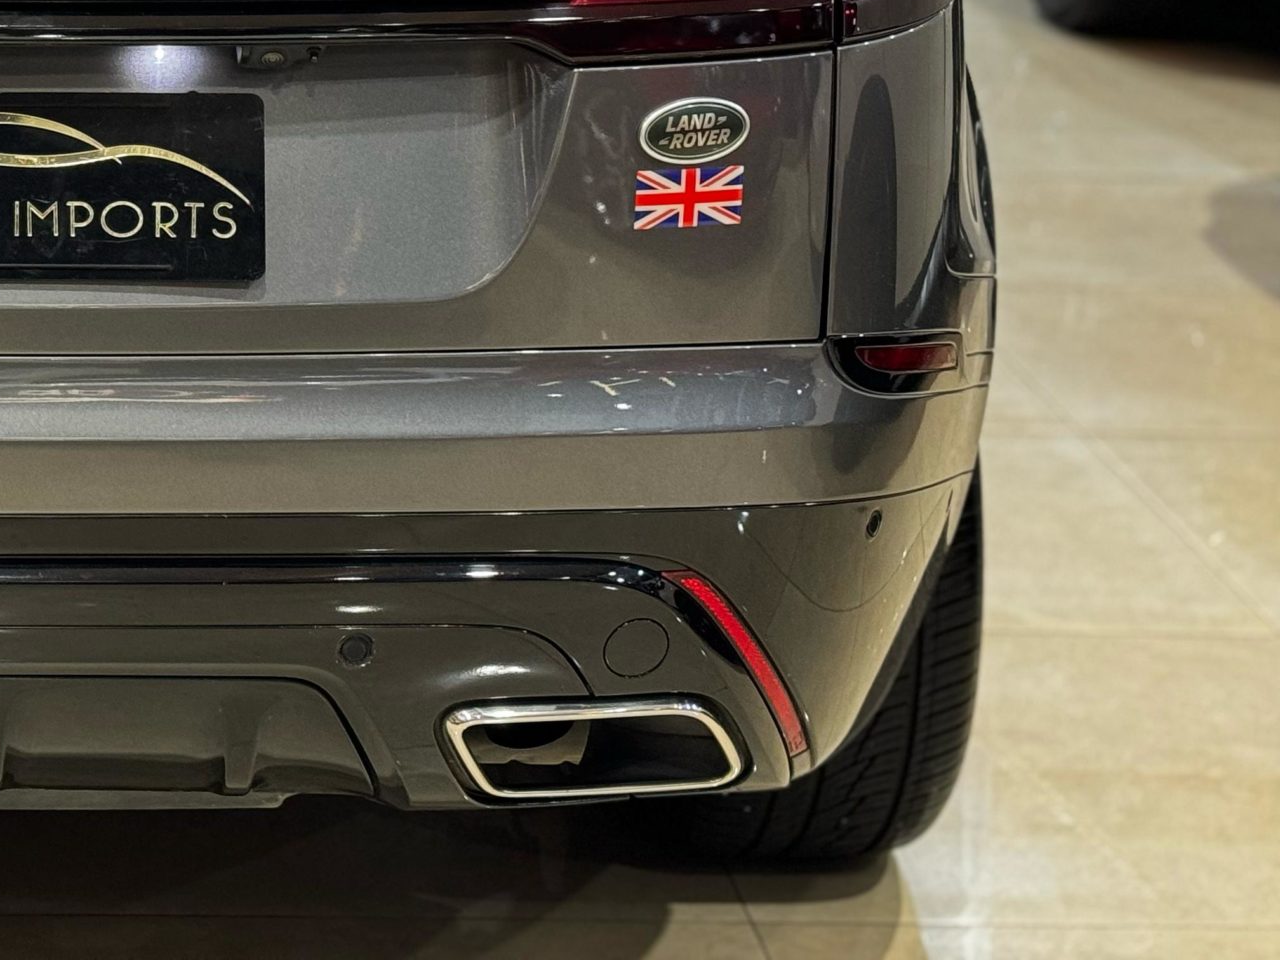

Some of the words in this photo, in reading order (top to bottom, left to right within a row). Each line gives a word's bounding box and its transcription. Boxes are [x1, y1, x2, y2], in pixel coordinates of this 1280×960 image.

[666, 113, 715, 132] LAND
[670, 128, 731, 149] ROVER
[13, 200, 238, 239] IMPORTS
